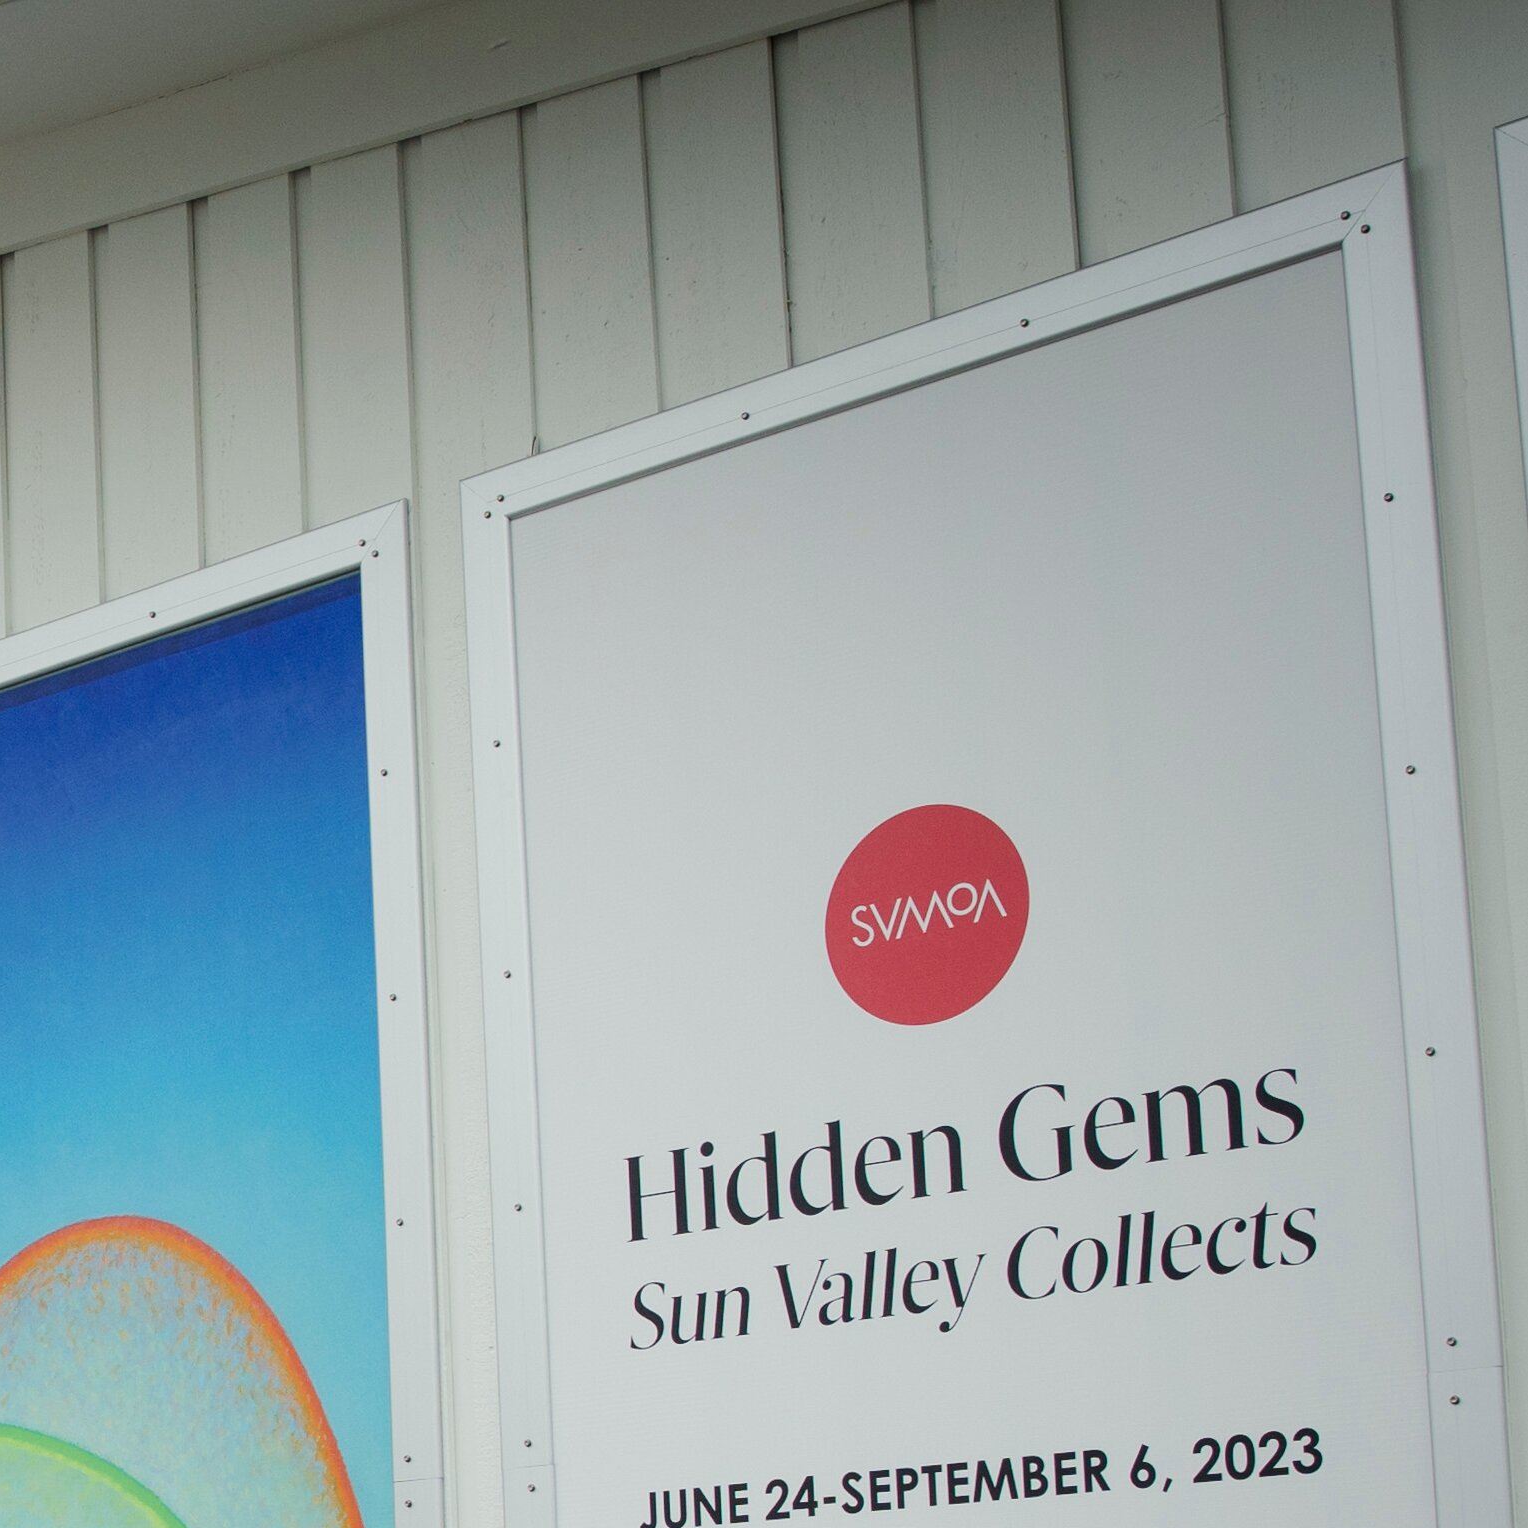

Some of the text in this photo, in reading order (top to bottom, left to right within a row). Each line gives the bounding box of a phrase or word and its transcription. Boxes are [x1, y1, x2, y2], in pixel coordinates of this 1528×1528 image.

[851, 879, 1007, 947] SVMOA
[625, 1068, 1305, 1242] Hidden Gems
[629, 1201, 1317, 1350] Sun Valley Collects
[765, 1449, 1112, 1521] 24-SEPTEMBER
[1130, 1443, 1173, 1493] 6,
[1192, 1427, 1324, 1484] 2023
